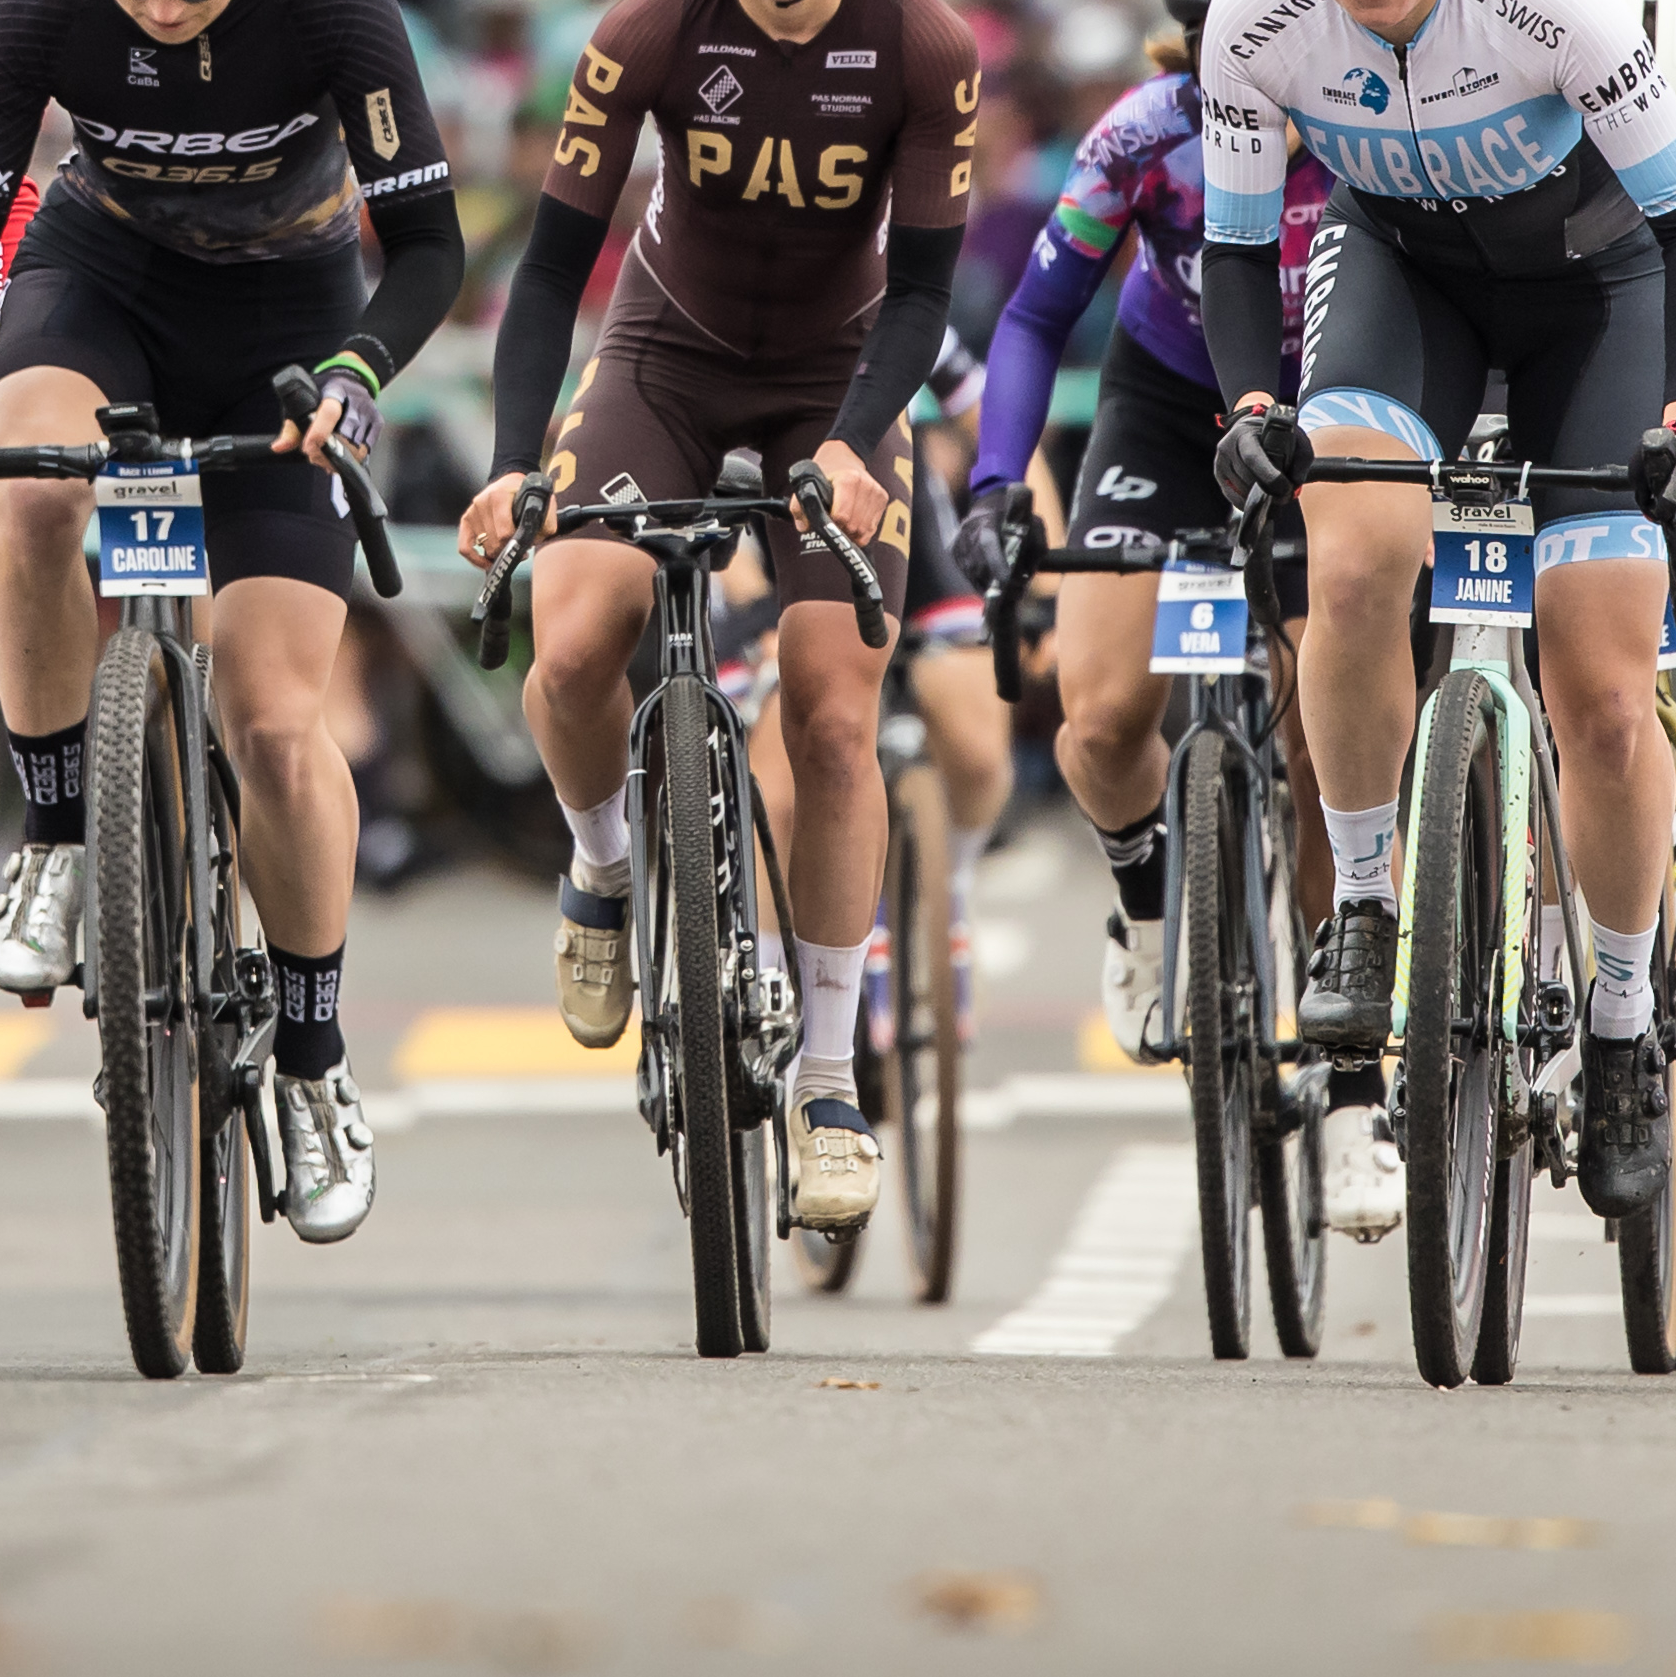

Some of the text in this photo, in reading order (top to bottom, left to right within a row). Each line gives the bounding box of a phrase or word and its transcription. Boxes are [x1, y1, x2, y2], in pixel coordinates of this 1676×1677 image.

[698, 44, 757, 58] SALOMON
[831, 55, 872, 65] VELUX
[811, 93, 873, 105] PAS NORMAL
[1322, 86, 1357, 101] EMBRACE
[1420, 89, 1455, 105] SEVEN
[1459, 71, 1500, 95] STONES
[554, 42, 625, 178] PAS
[820, 103, 862, 114] STUDIOS
[1593, 103, 1633, 136] THE
[72, 112, 320, 156] ORBEA
[687, 129, 869, 210] PAS
[1306, 113, 1556, 198] EMBRACE
[102, 156, 284, 184] Q36.5
[361, 160, 449, 199] SRAM
[114, 480, 177, 500] gravel
[1449, 475, 1490, 485] wahoo
[130, 510, 175, 542] 17
[1450, 505, 1511, 522] gravel
[112, 545, 197, 573] CAROLINE
[1464, 539, 1508, 573] 18
[1538, 525, 1610, 574] DT
[1454, 576, 1514, 604] JANINE
[1190, 602, 1215, 631] 6
[1179, 631, 1221, 654] VERA
